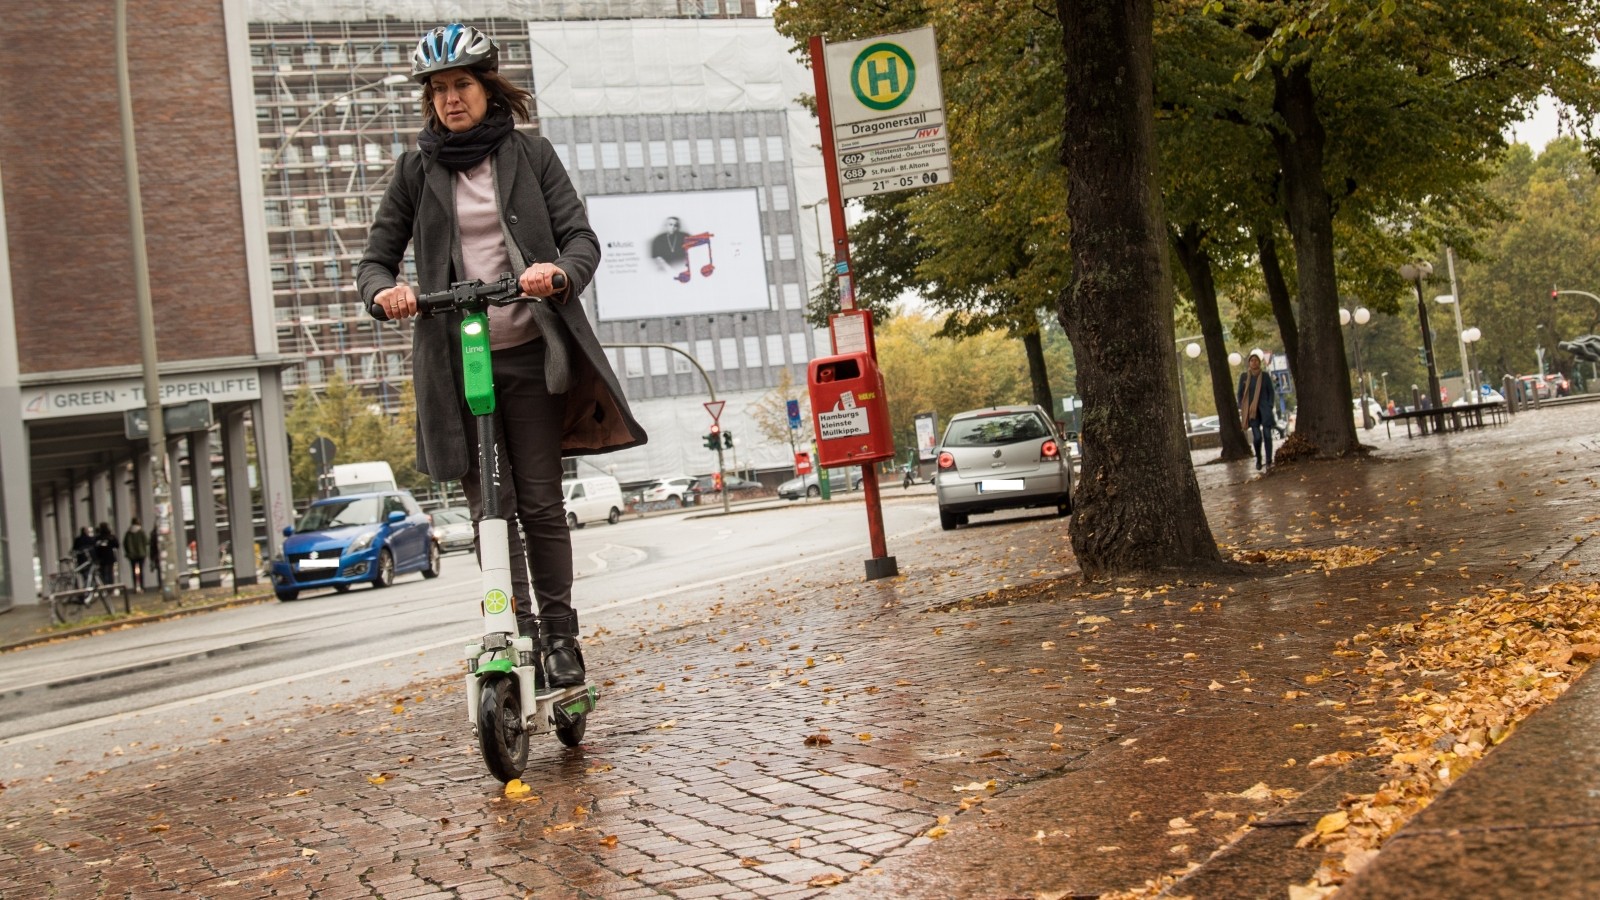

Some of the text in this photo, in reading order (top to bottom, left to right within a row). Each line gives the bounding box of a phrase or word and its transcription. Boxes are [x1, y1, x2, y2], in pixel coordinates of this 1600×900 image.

[867, 57, 899, 97] H
[851, 112, 927, 135] Dragonerstall
[918, 128, 940, 138] HVV
[875, 145, 914, 156] Holstenstraße
[918, 142, 935, 150] Lurup
[845, 154, 863, 164] 602
[871, 152, 902, 163] Schenefeld
[905, 148, 931, 158] Osdorfer
[846, 168, 864, 178] 688
[871, 168, 880, 176] St.
[880, 166, 896, 174] Pauli
[909, 161, 930, 169] Altona
[465, 345, 484, 354] Lime
[53, 389, 116, 409] GREEN
[131, 377, 257, 401] TEPPENLIFTE
[820, 412, 859, 421] Hamburgs
[821, 420, 852, 429] kleinste
[822, 427, 862, 436] Müllkippe.
